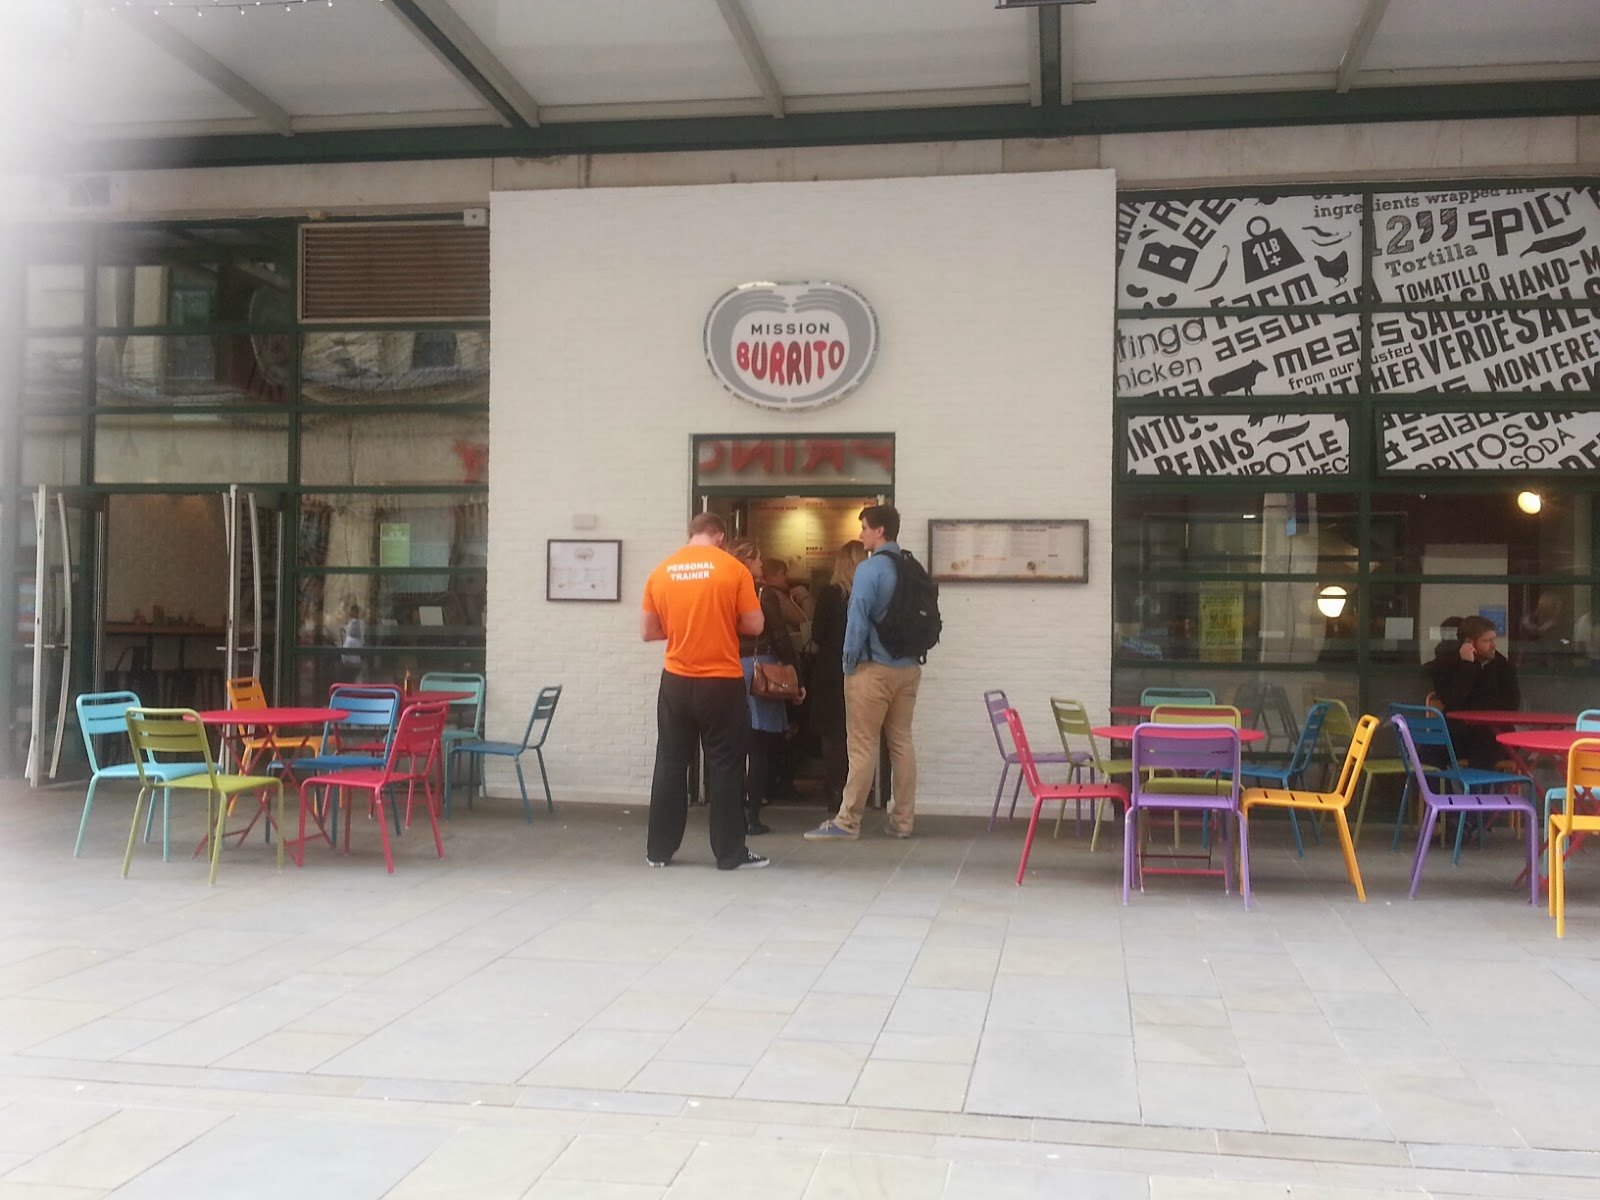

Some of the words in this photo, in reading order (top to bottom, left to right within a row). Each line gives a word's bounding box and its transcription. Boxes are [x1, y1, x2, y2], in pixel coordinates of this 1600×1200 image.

[1385, 243, 1478, 278] Tortilla
[1210, 273, 1318, 329] farm
[1395, 262, 1491, 304] TOMATILLO
[751, 323, 830, 335] MISSION
[1419, 316, 1515, 375] VERDE
[736, 340, 845, 386] BURRITO
[1288, 372, 1325, 390] from
[1329, 362, 1355, 378] our
[1510, 427, 1576, 469] SODA
[667, 561, 715, 573] PERSONAL
[670, 570, 710, 581] TRAINER
